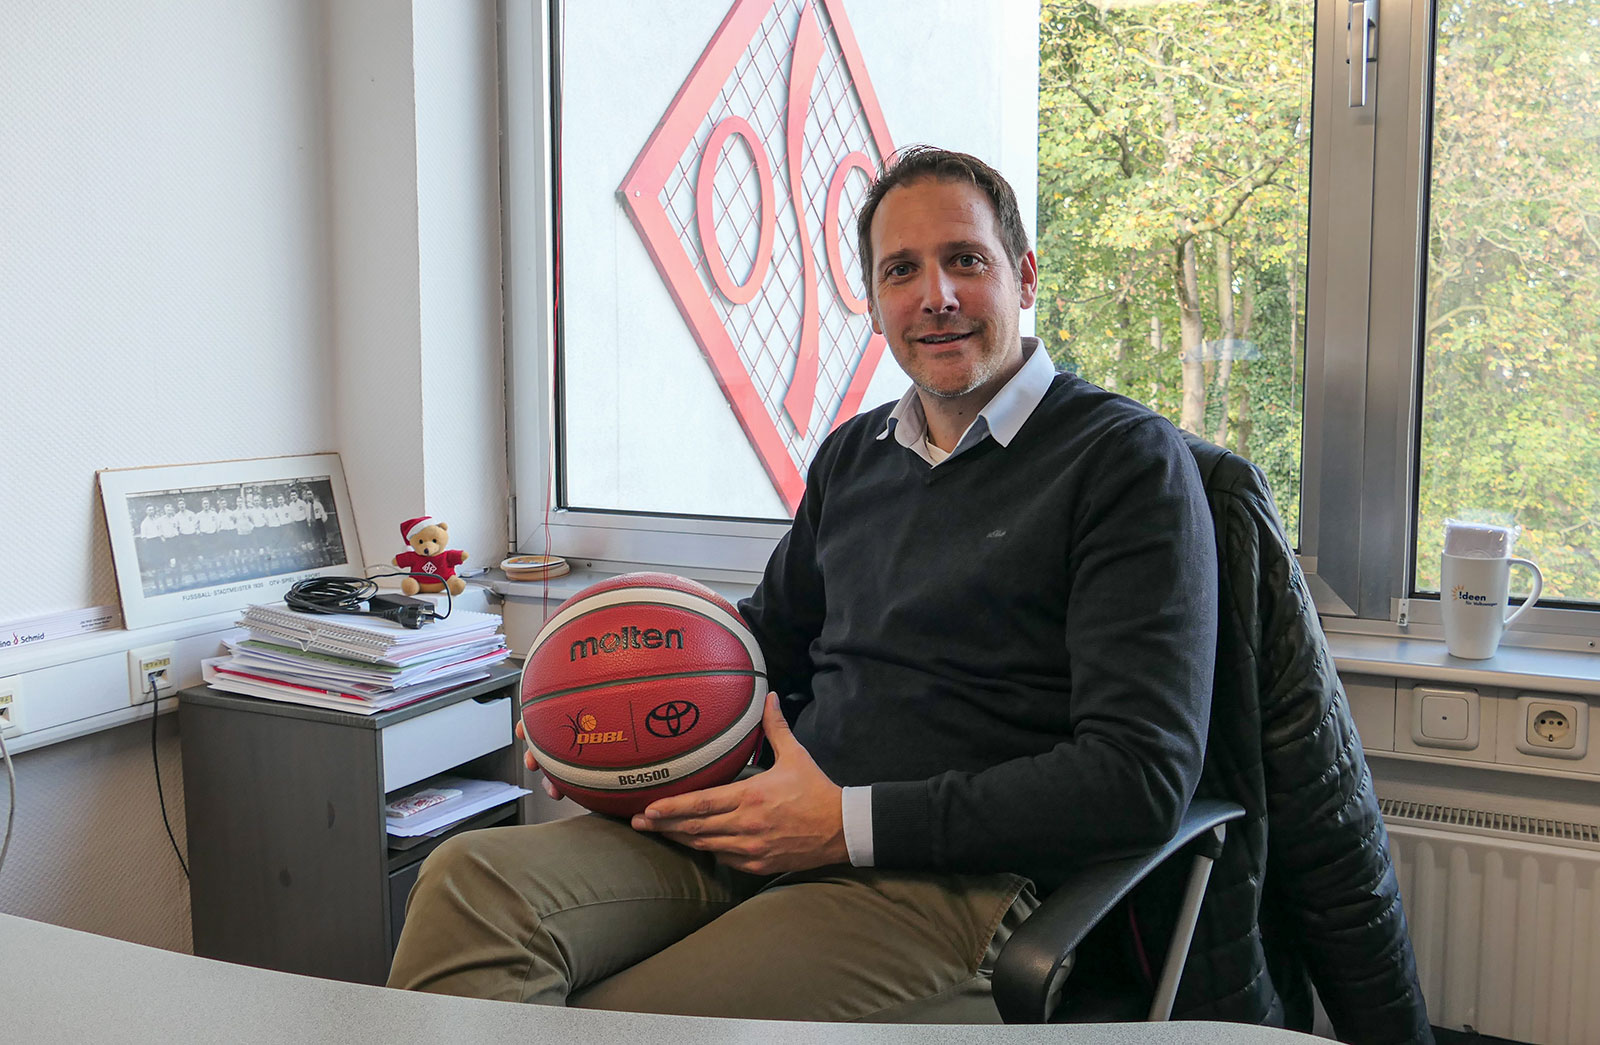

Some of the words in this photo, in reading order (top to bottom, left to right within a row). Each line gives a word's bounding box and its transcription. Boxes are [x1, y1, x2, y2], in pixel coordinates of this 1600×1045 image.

[20, 632, 45, 644] Schmid
[570, 625, 684, 662] molten
[577, 730, 629, 744] DBBL
[618, 767, 670, 786] BG4500
